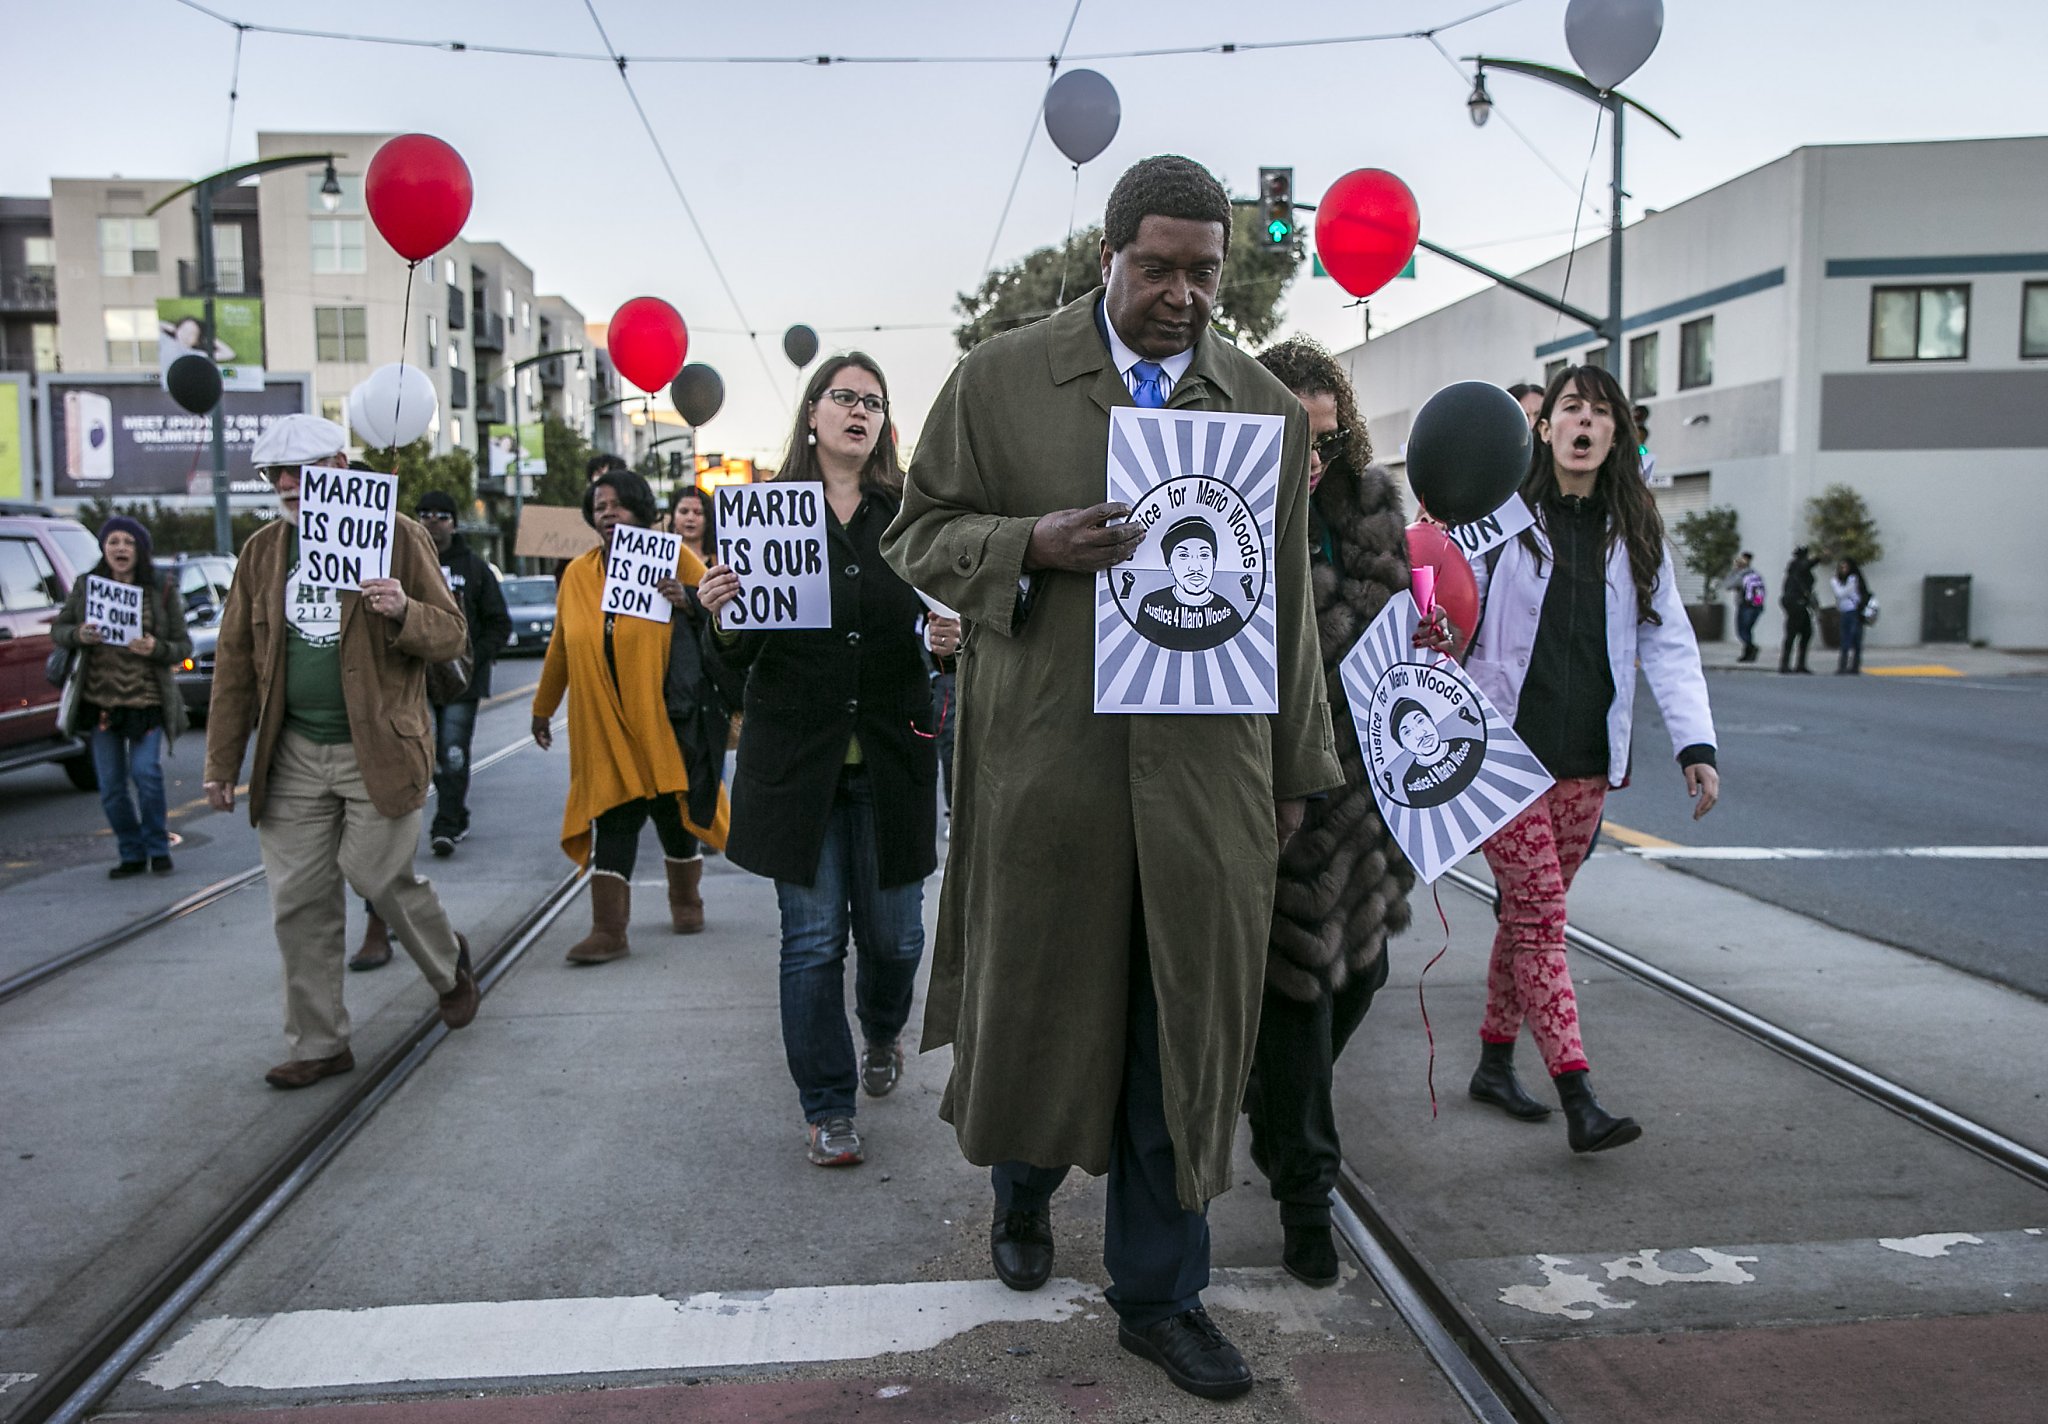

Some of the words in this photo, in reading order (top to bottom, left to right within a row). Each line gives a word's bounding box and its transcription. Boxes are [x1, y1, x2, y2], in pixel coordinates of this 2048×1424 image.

[122, 415, 164, 430] MEET
[166, 415, 213, 430] IPHON
[133, 429, 213, 443] UNLIMITED
[304, 470, 391, 511] MARIO
[719, 489, 817, 528] MARIO
[302, 510, 329, 543] IS
[338, 516, 388, 550] OUR
[1168, 485, 1187, 509] for
[1196, 480, 1229, 513] Mario
[1226, 503, 1259, 569] Woods
[615, 528, 676, 562] MARIO
[719, 538, 752, 577] IS
[763, 538, 822, 577] OUR
[308, 550, 361, 585] SON
[610, 557, 632, 582] IS
[90, 580, 138, 607] MARIO
[608, 586, 652, 614] SON
[730, 584, 797, 625] SON
[89, 601, 105, 619] IS
[109, 608, 138, 626] OUR
[1145, 602, 1173, 626] Justice
[1173, 606, 1180, 627] 4
[1181, 606, 1203, 628] Mario
[1204, 606, 1231, 626] Woods
[101, 625, 124, 641] ON
[1388, 667, 1409, 690] Mario
[1414, 668, 1463, 705] Woods
[1377, 686, 1388, 707] for
[1371, 711, 1385, 765] Justice
[1448, 741, 1471, 767] Woods
[1427, 770, 1440, 785] 4
[1431, 760, 1457, 782] Mario
